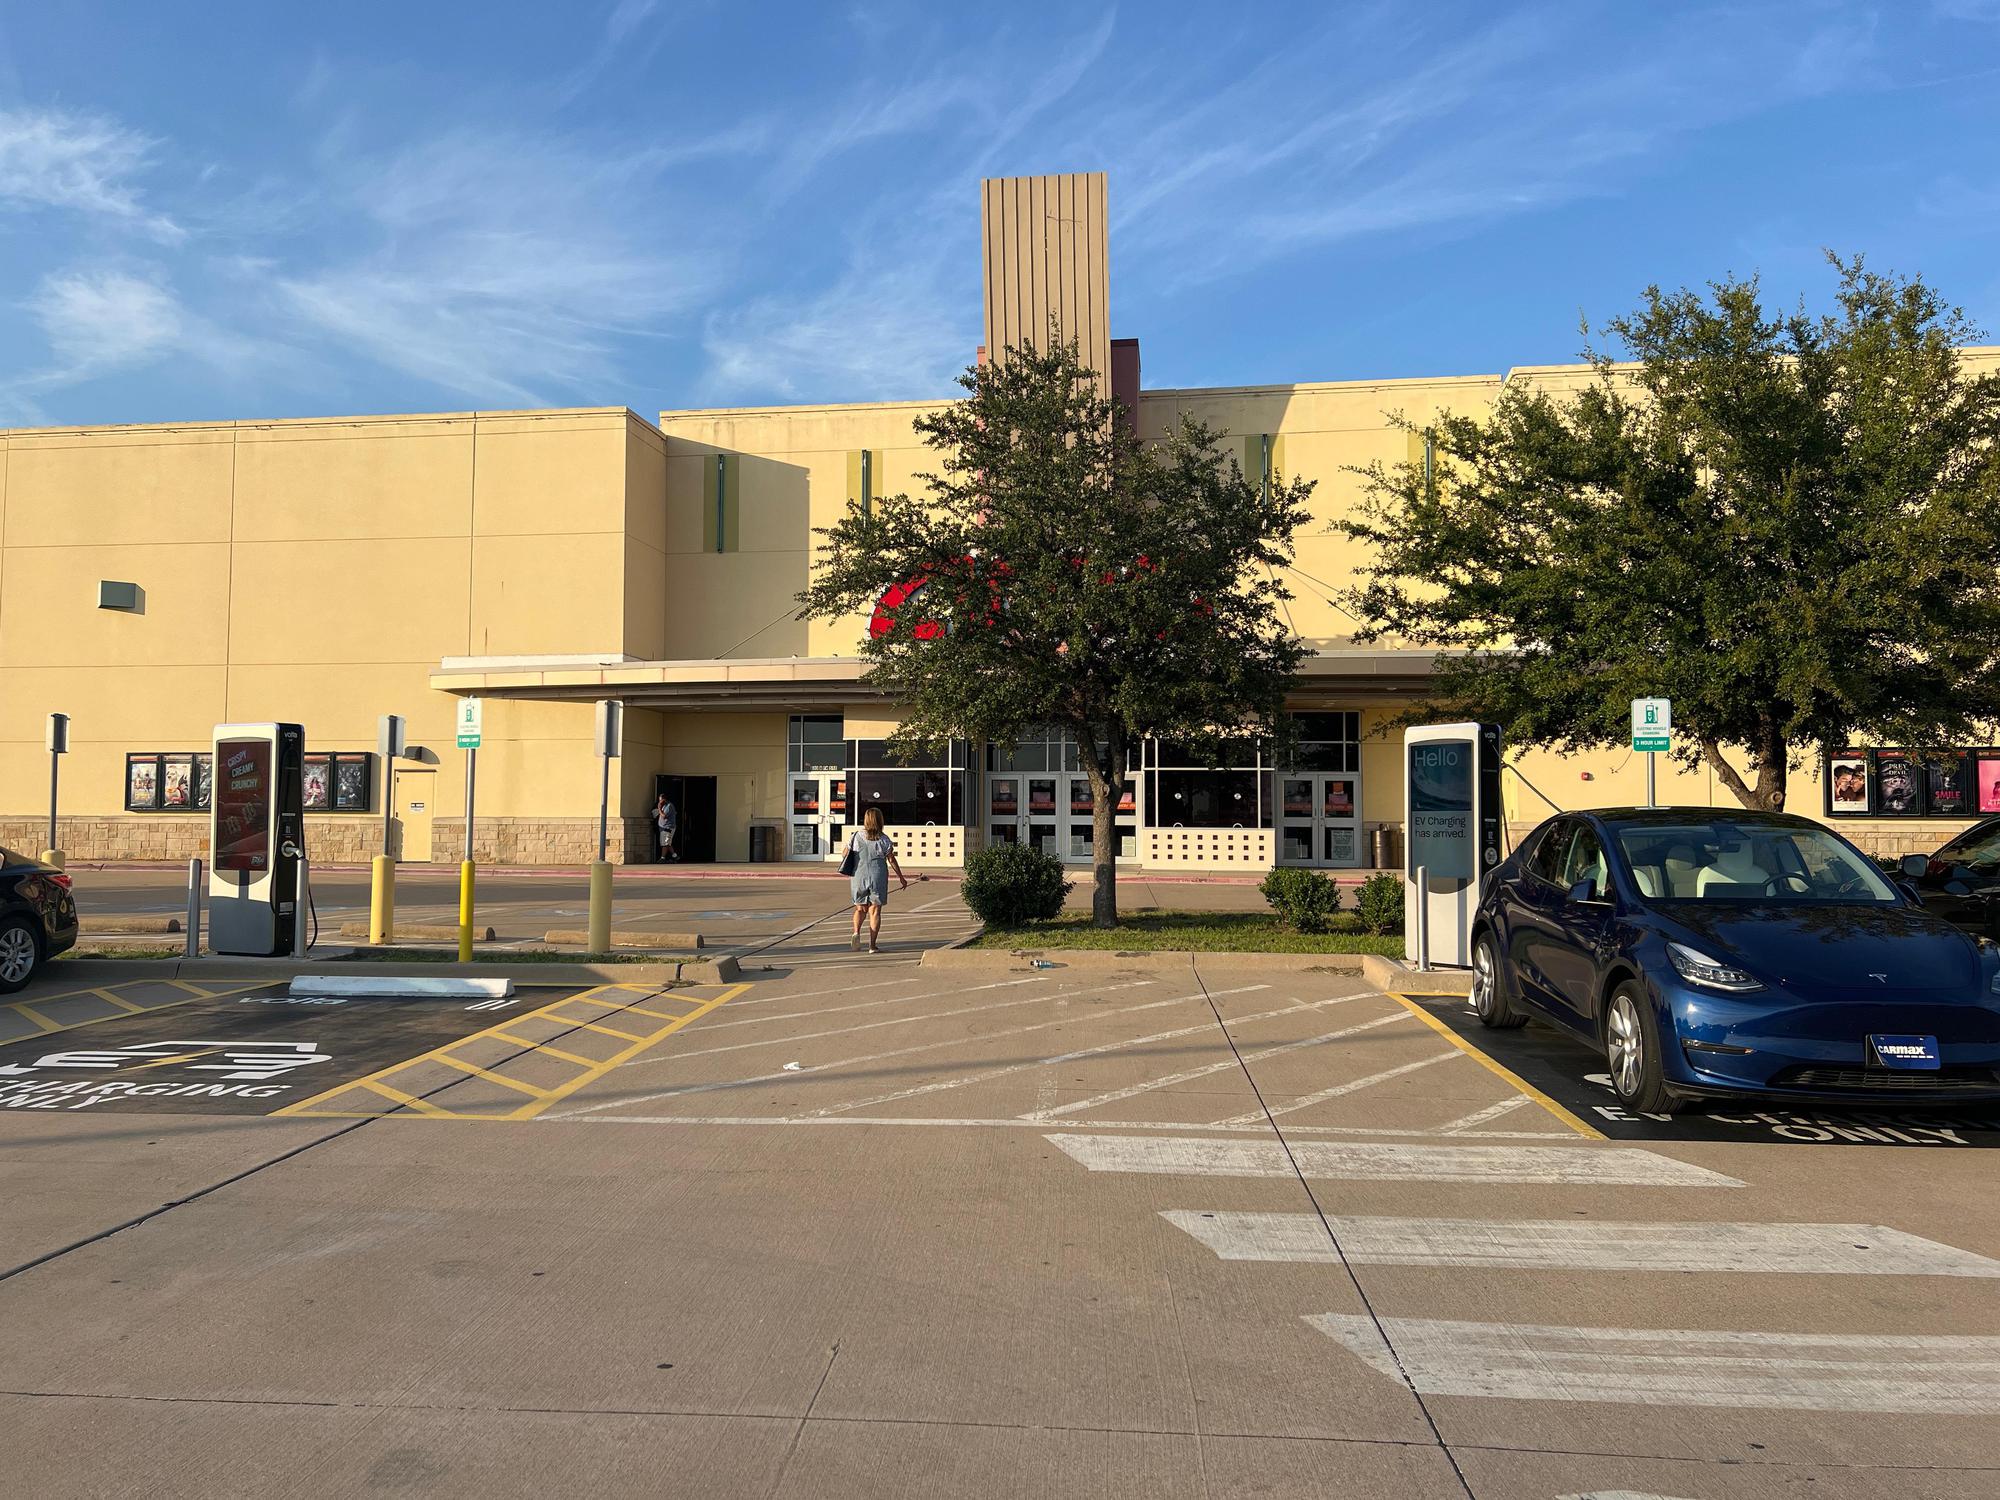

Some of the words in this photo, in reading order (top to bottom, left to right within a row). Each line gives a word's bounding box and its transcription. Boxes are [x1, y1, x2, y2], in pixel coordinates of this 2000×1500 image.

[227, 750, 247, 768] CRISPY
[1414, 748, 1458, 767] Hello
[231, 762, 254, 778] CREAMY
[231, 778, 257, 790] CRUNCHY
[1935, 790, 1961, 799] SMILE
[1415, 817, 1427, 826] EV
[1427, 816, 1466, 828] Charging
[1415, 829, 1431, 838] has
[1432, 829, 1467, 838] arrived.
[0, 1094, 128, 1109] NLY
[1771, 1124, 1971, 1144] ONLY
